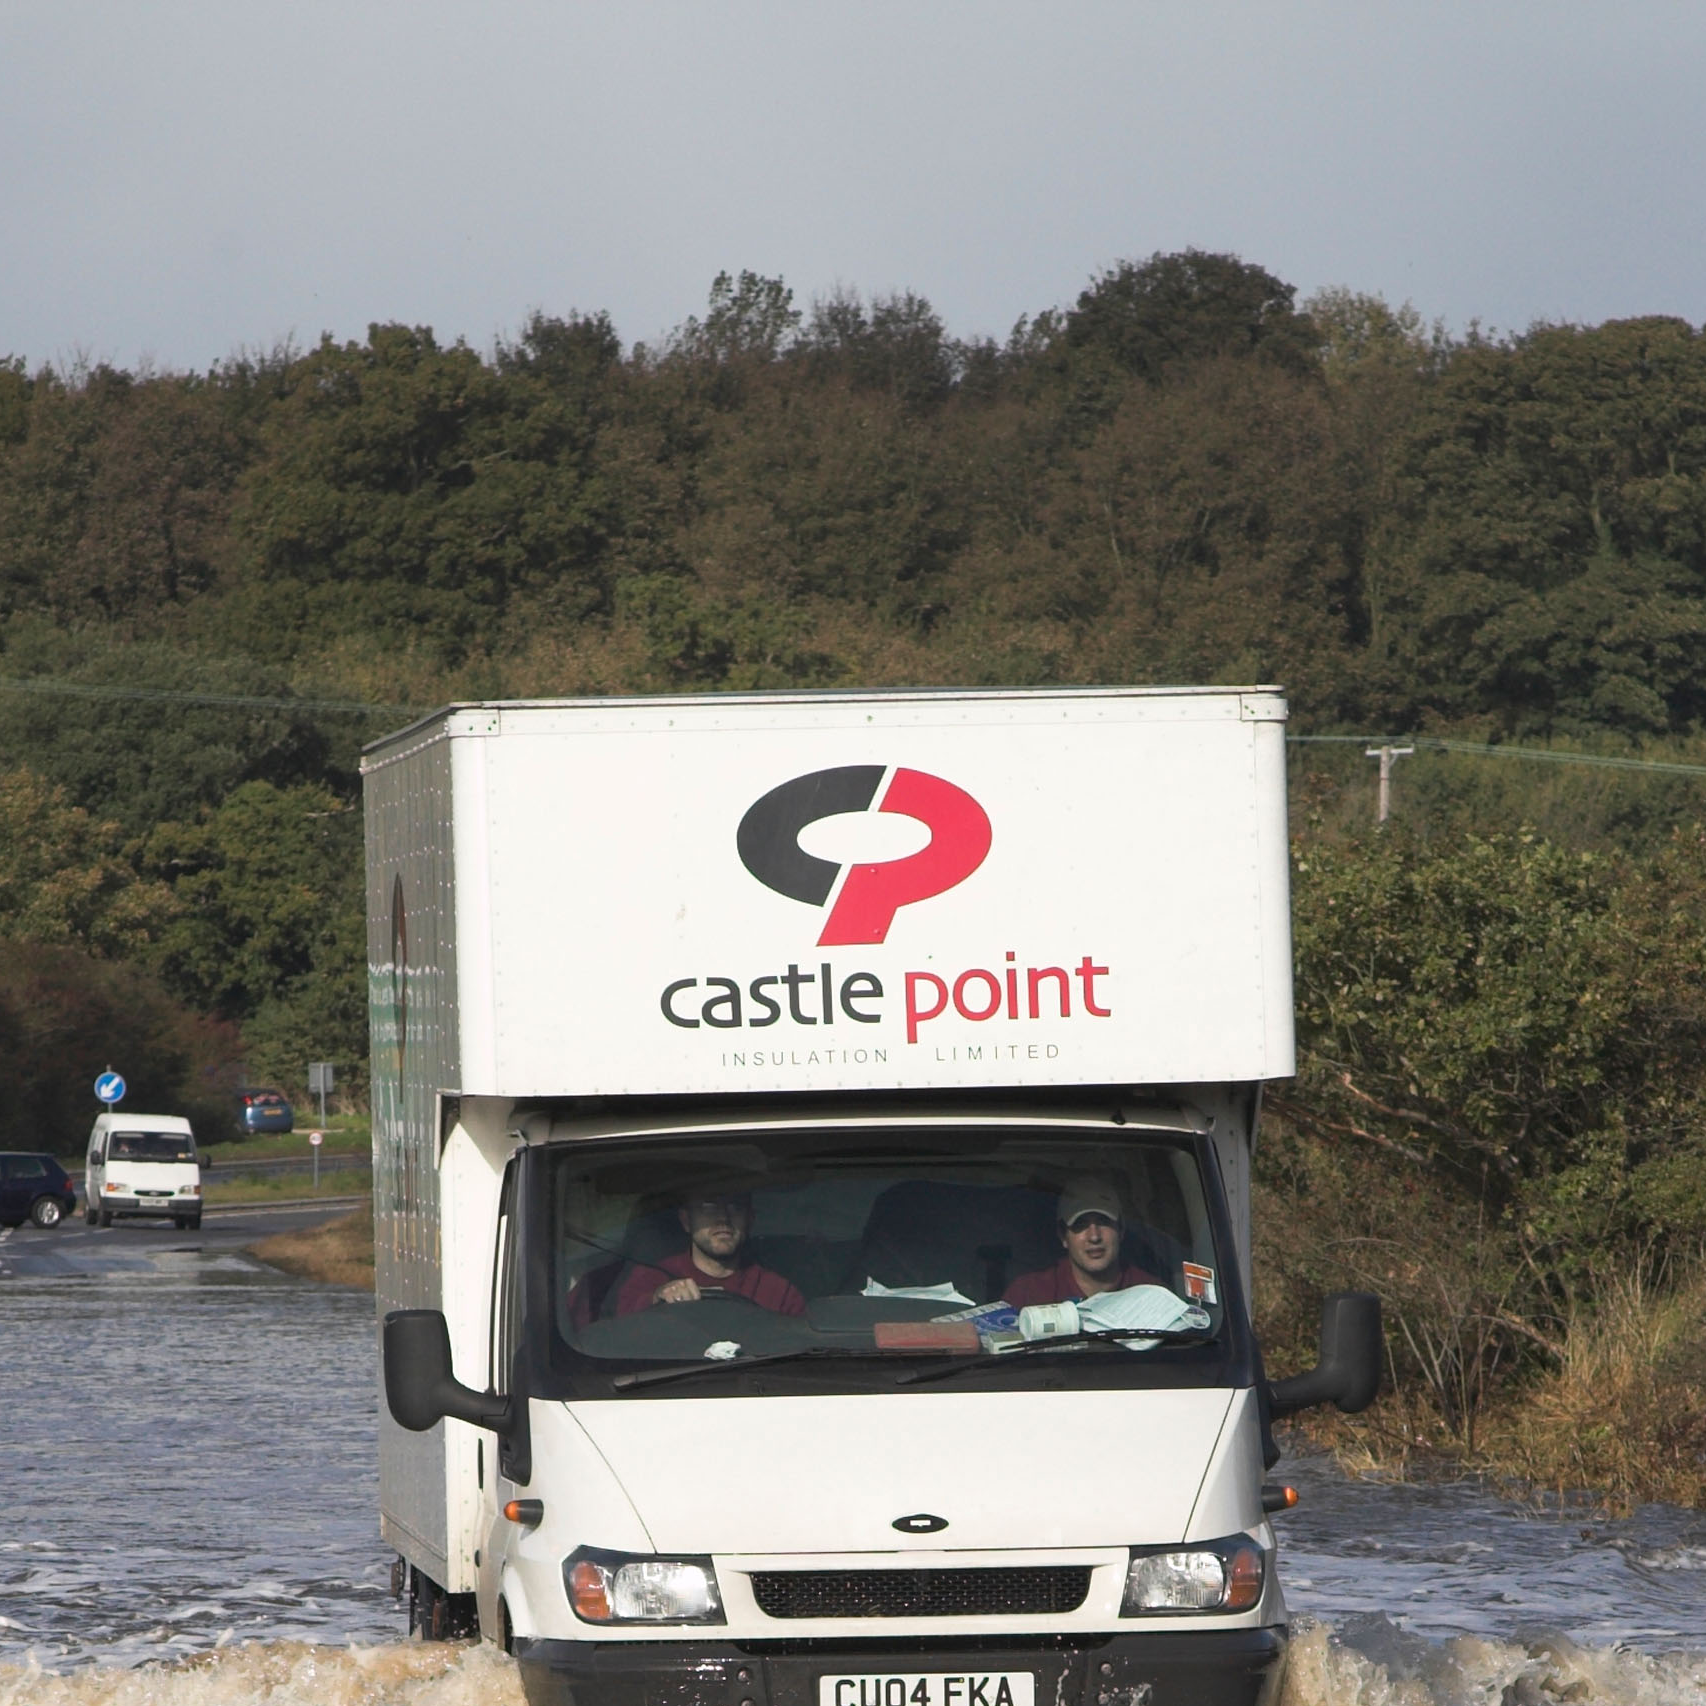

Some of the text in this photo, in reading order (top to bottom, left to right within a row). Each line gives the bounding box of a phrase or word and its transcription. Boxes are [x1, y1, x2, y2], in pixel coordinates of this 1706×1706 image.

[660, 951, 1112, 1044] castle point
[722, 1044, 1059, 1067] INSULATION LIMITED
